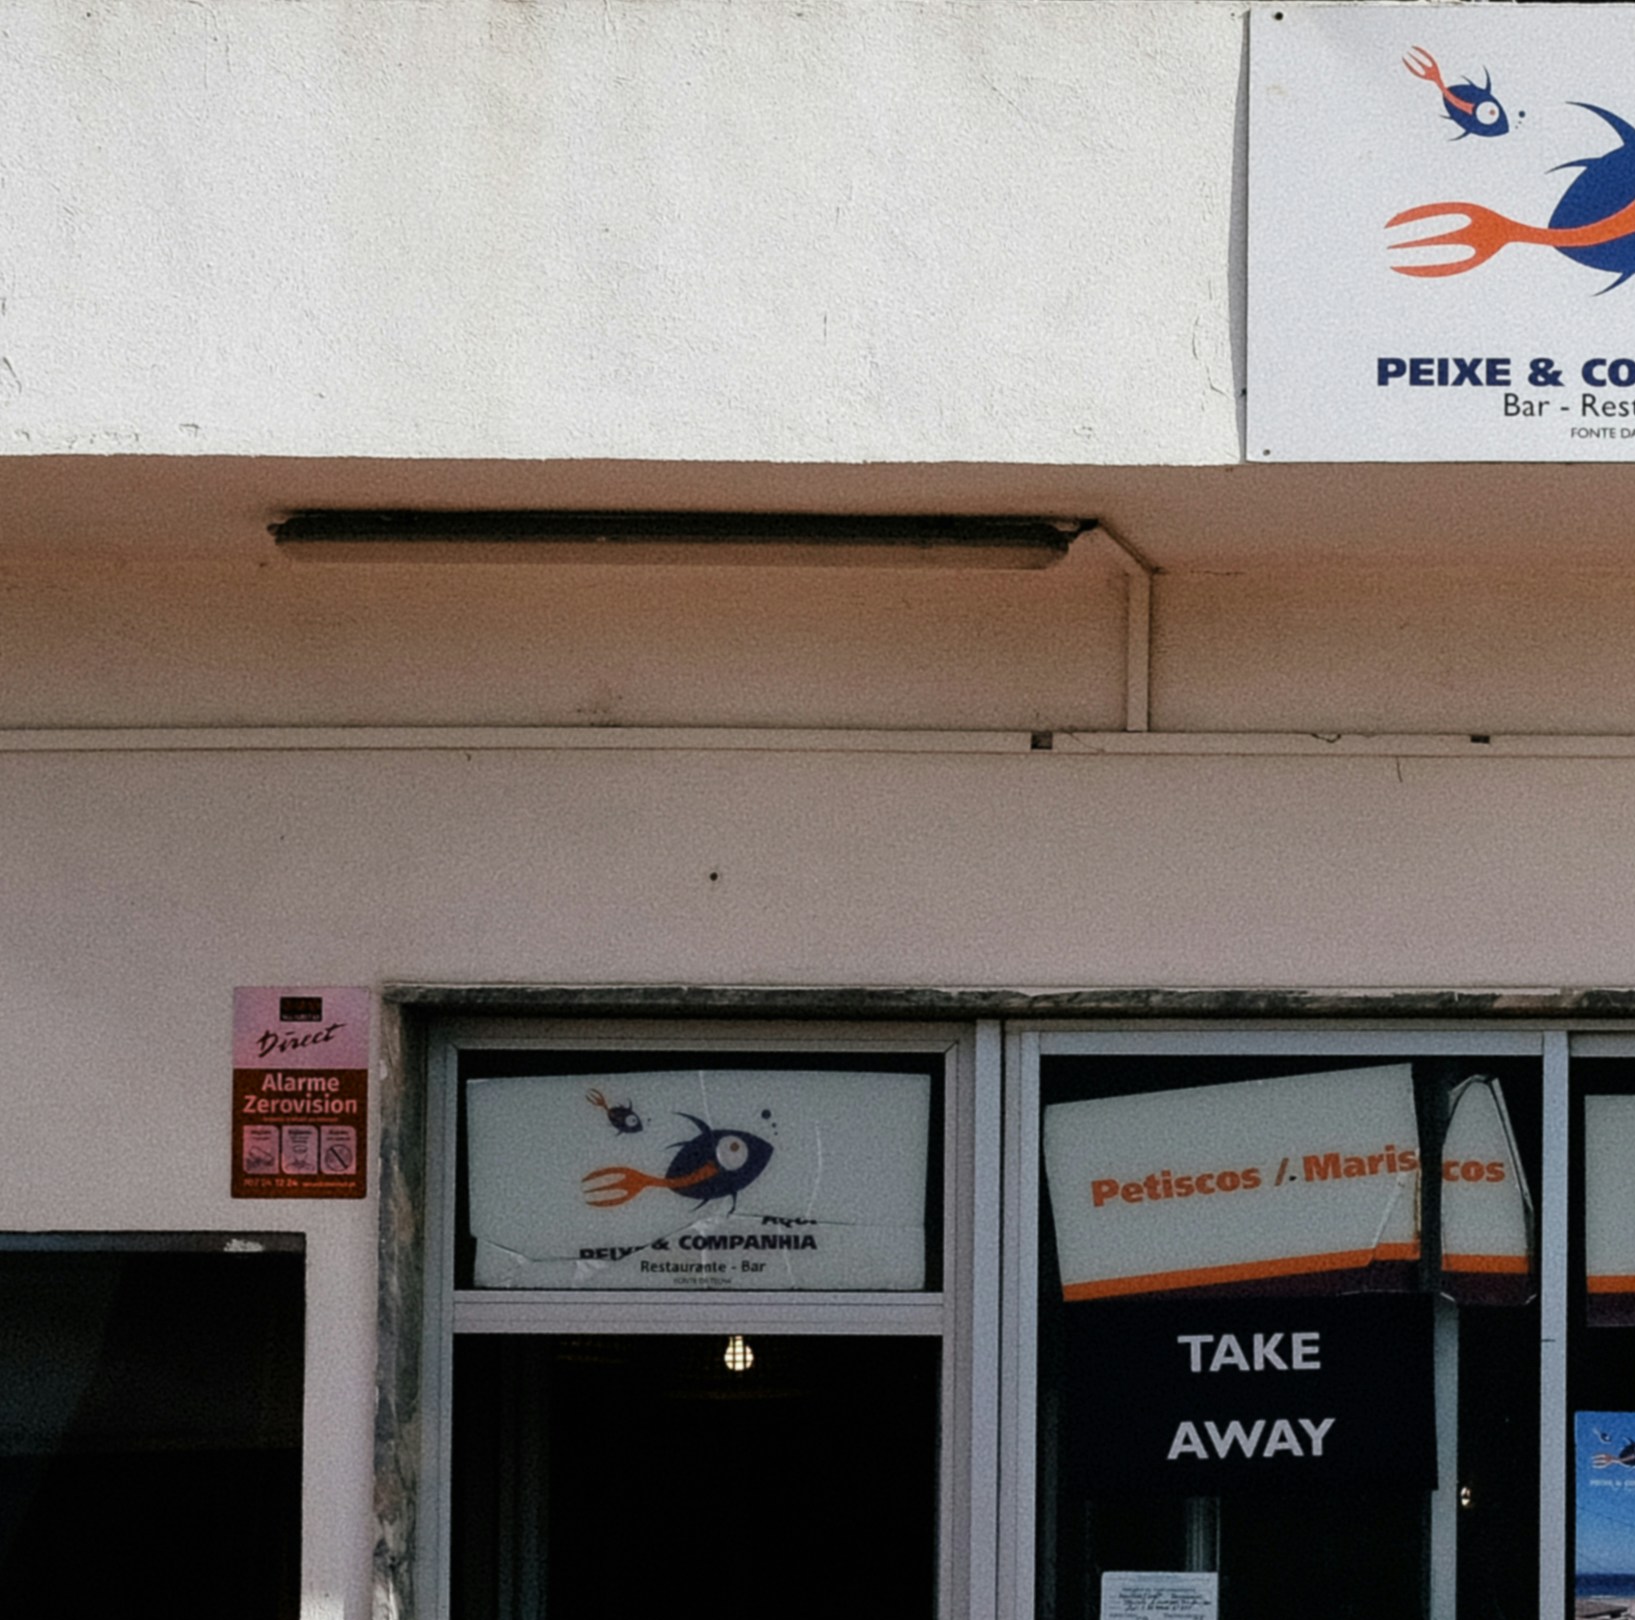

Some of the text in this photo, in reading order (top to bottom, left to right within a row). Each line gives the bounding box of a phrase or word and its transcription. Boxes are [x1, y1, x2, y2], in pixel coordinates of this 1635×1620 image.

[1378, 358, 1511, 386] PEIXE
[1528, 358, 1563, 386] &
[1504, 393, 1549, 416] Bar
[1571, 427, 1615, 439] FONTE
[256, 1023, 347, 1058] Direct
[261, 1073, 340, 1091] Alarme
[242, 1094, 357, 1114] Zerovision
[1091, 1161, 1261, 1207] Petiscos
[679, 1235, 817, 1250] COMPANHIA
[640, 1260, 727, 1273] Restaurante
[741, 1260, 766, 1272] Bar
[1178, 1332, 1320, 1372] TAKE
[1168, 1418, 1335, 1459] AWAY
